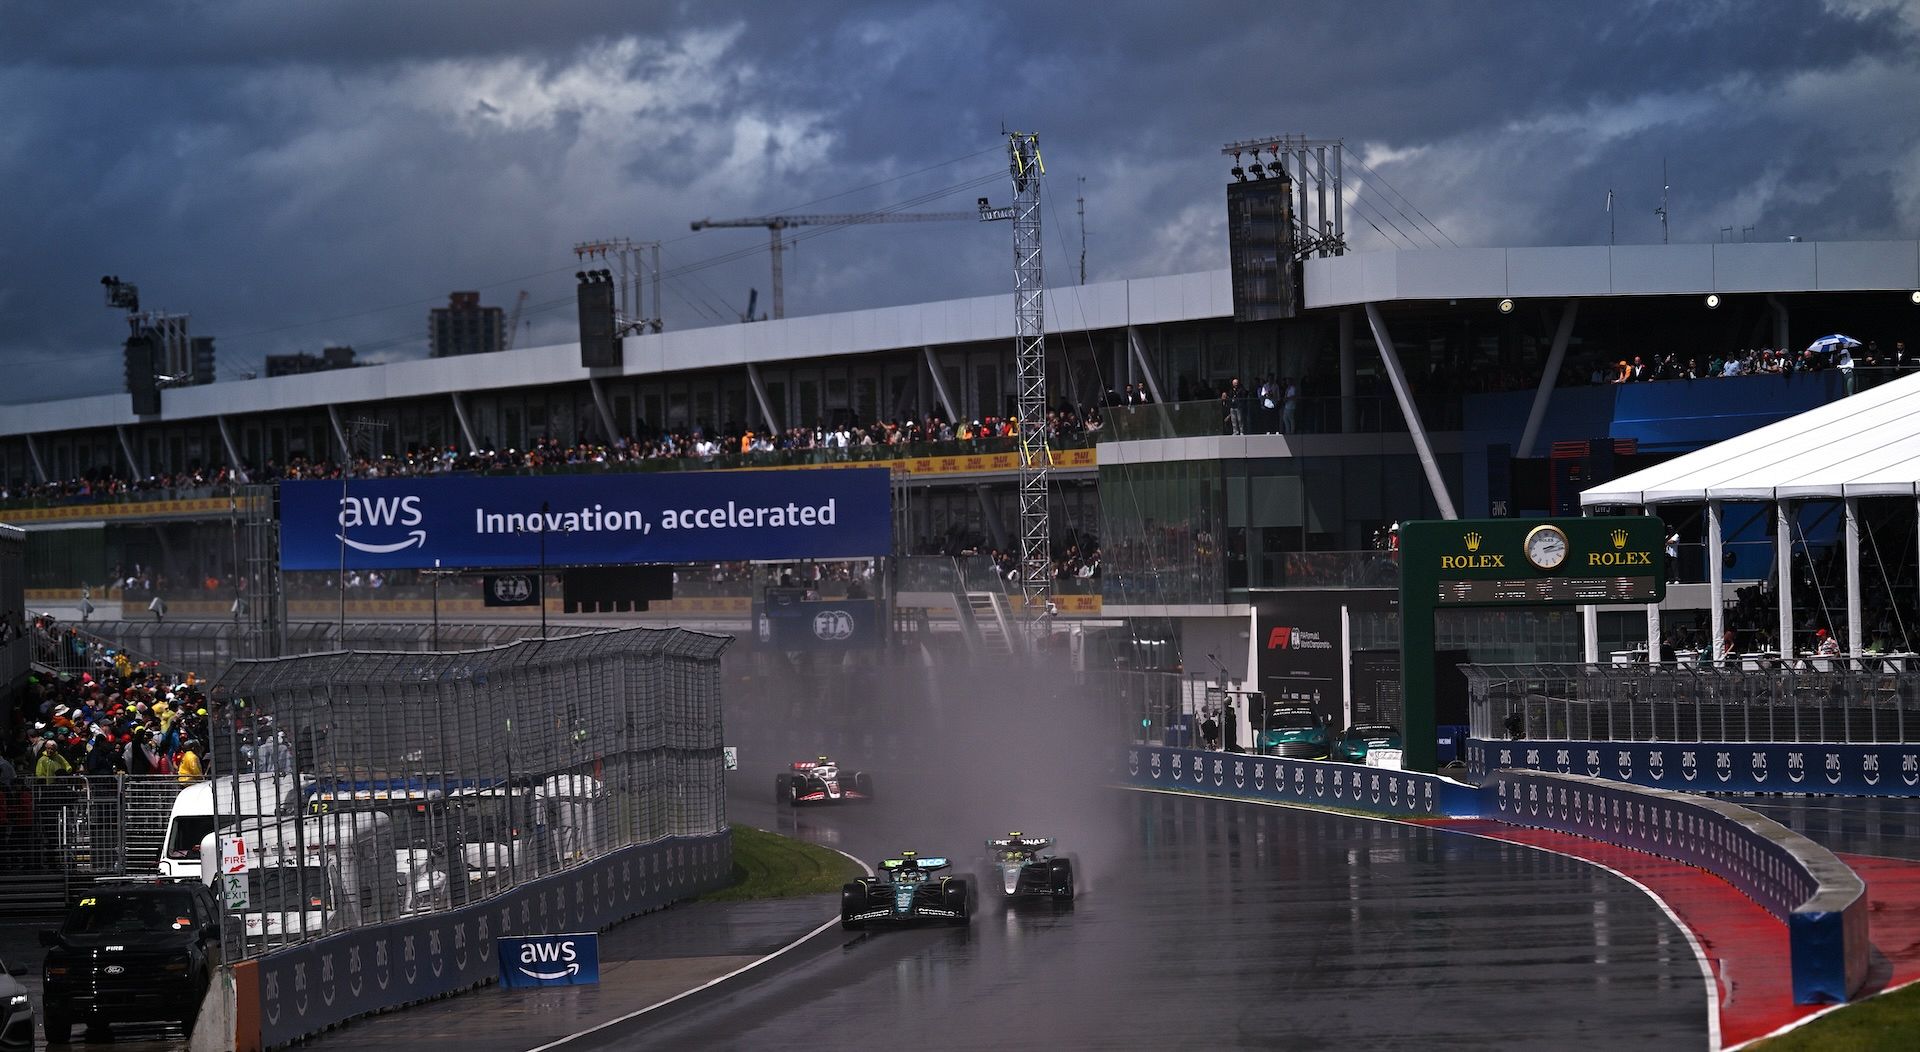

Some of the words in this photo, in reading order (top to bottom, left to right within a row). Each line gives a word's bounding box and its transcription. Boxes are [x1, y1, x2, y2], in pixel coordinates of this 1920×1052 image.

[338, 494, 423, 528] aws
[476, 504, 652, 535] Innovation,
[661, 498, 836, 530] accelerated
[1491, 501, 1508, 517] aws
[1441, 554, 1506, 569] ROLEX
[1588, 551, 1652, 566] ROLEX
[495, 577, 530, 598] FIA
[815, 615, 851, 636] FIA
[224, 856, 246, 864] FIRE
[80, 898, 97, 907] F1
[225, 891, 248, 900] EXIT
[520, 940, 578, 964] aws
